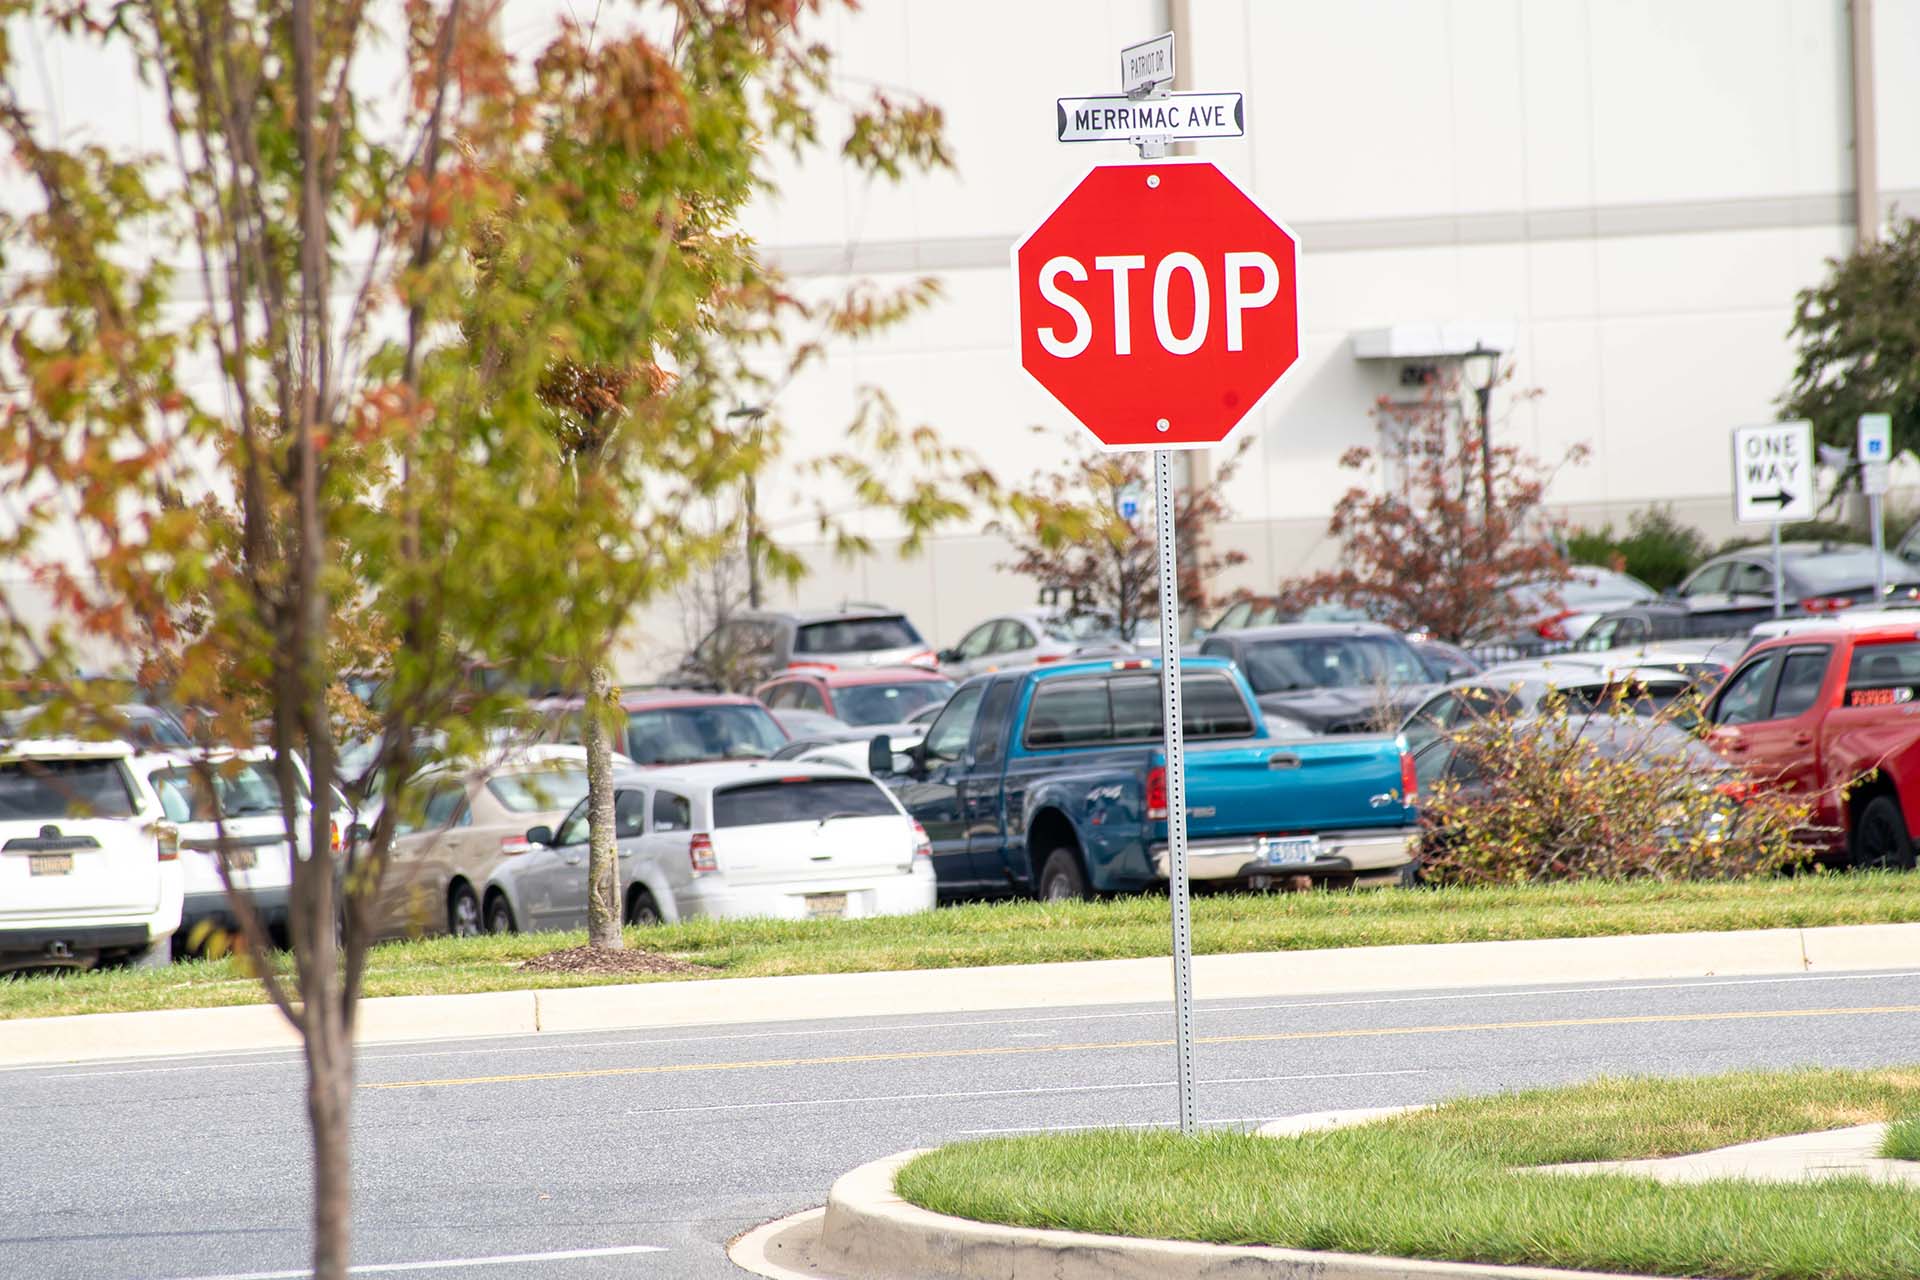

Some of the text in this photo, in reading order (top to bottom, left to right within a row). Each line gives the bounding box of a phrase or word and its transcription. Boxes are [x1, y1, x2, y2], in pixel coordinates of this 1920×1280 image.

[1130, 49, 1165, 81] PATRIOT DR
[1075, 106, 1225, 130] MERRIMAC AVE
[1037, 251, 1280, 358] STOP
[1746, 435, 1797, 457] ONE
[1746, 463, 1798, 482] WAY
